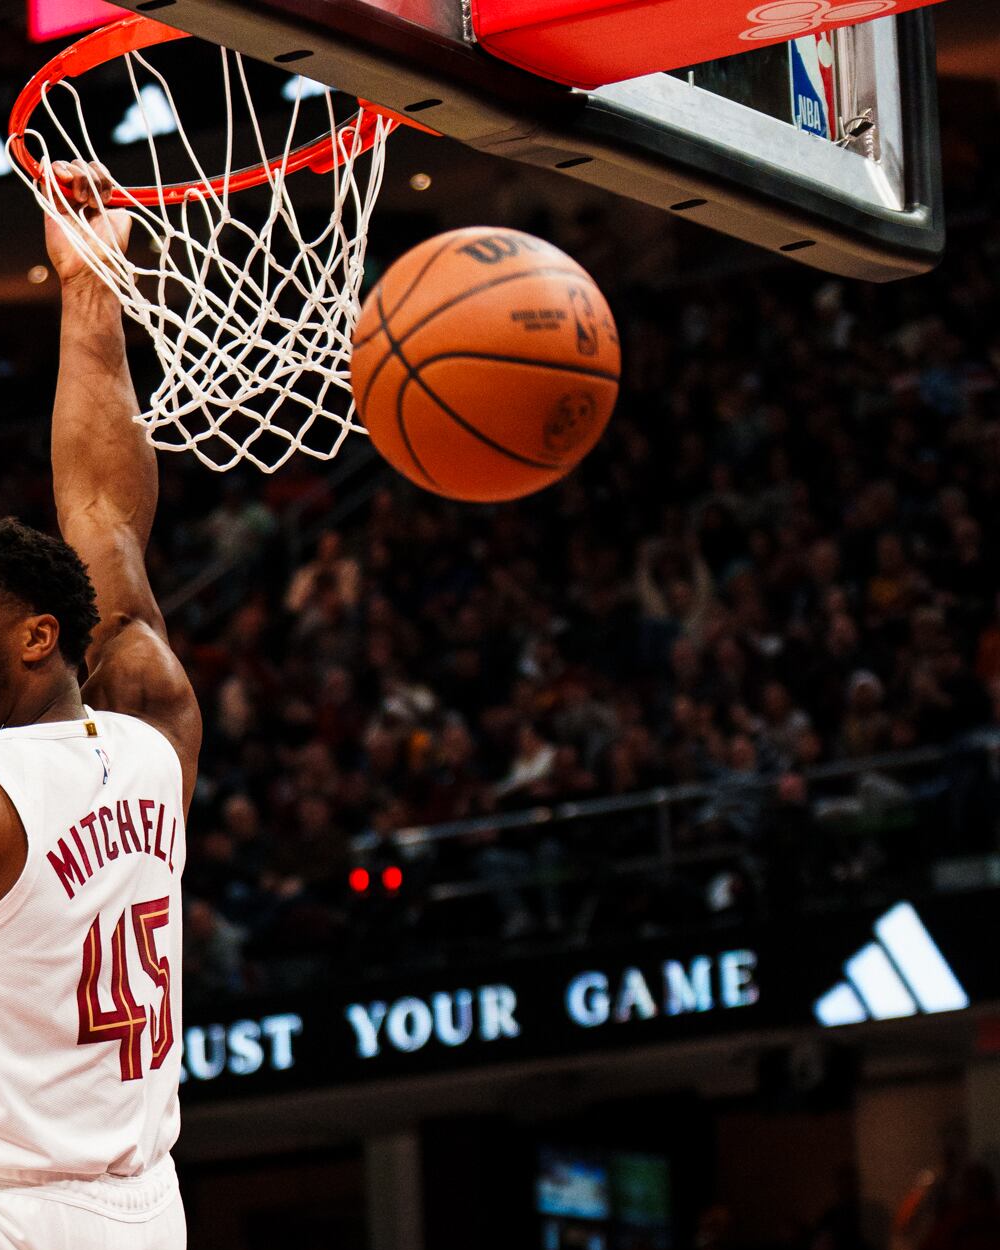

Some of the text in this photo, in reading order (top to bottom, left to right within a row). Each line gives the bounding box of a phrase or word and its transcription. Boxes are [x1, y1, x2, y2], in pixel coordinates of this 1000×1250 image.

[798, 94, 821, 131] NBA
[46, 798, 177, 900] MITCHELL
[77, 895, 174, 1081] 45
[178, 951, 760, 1083] UST YOUR GAME
